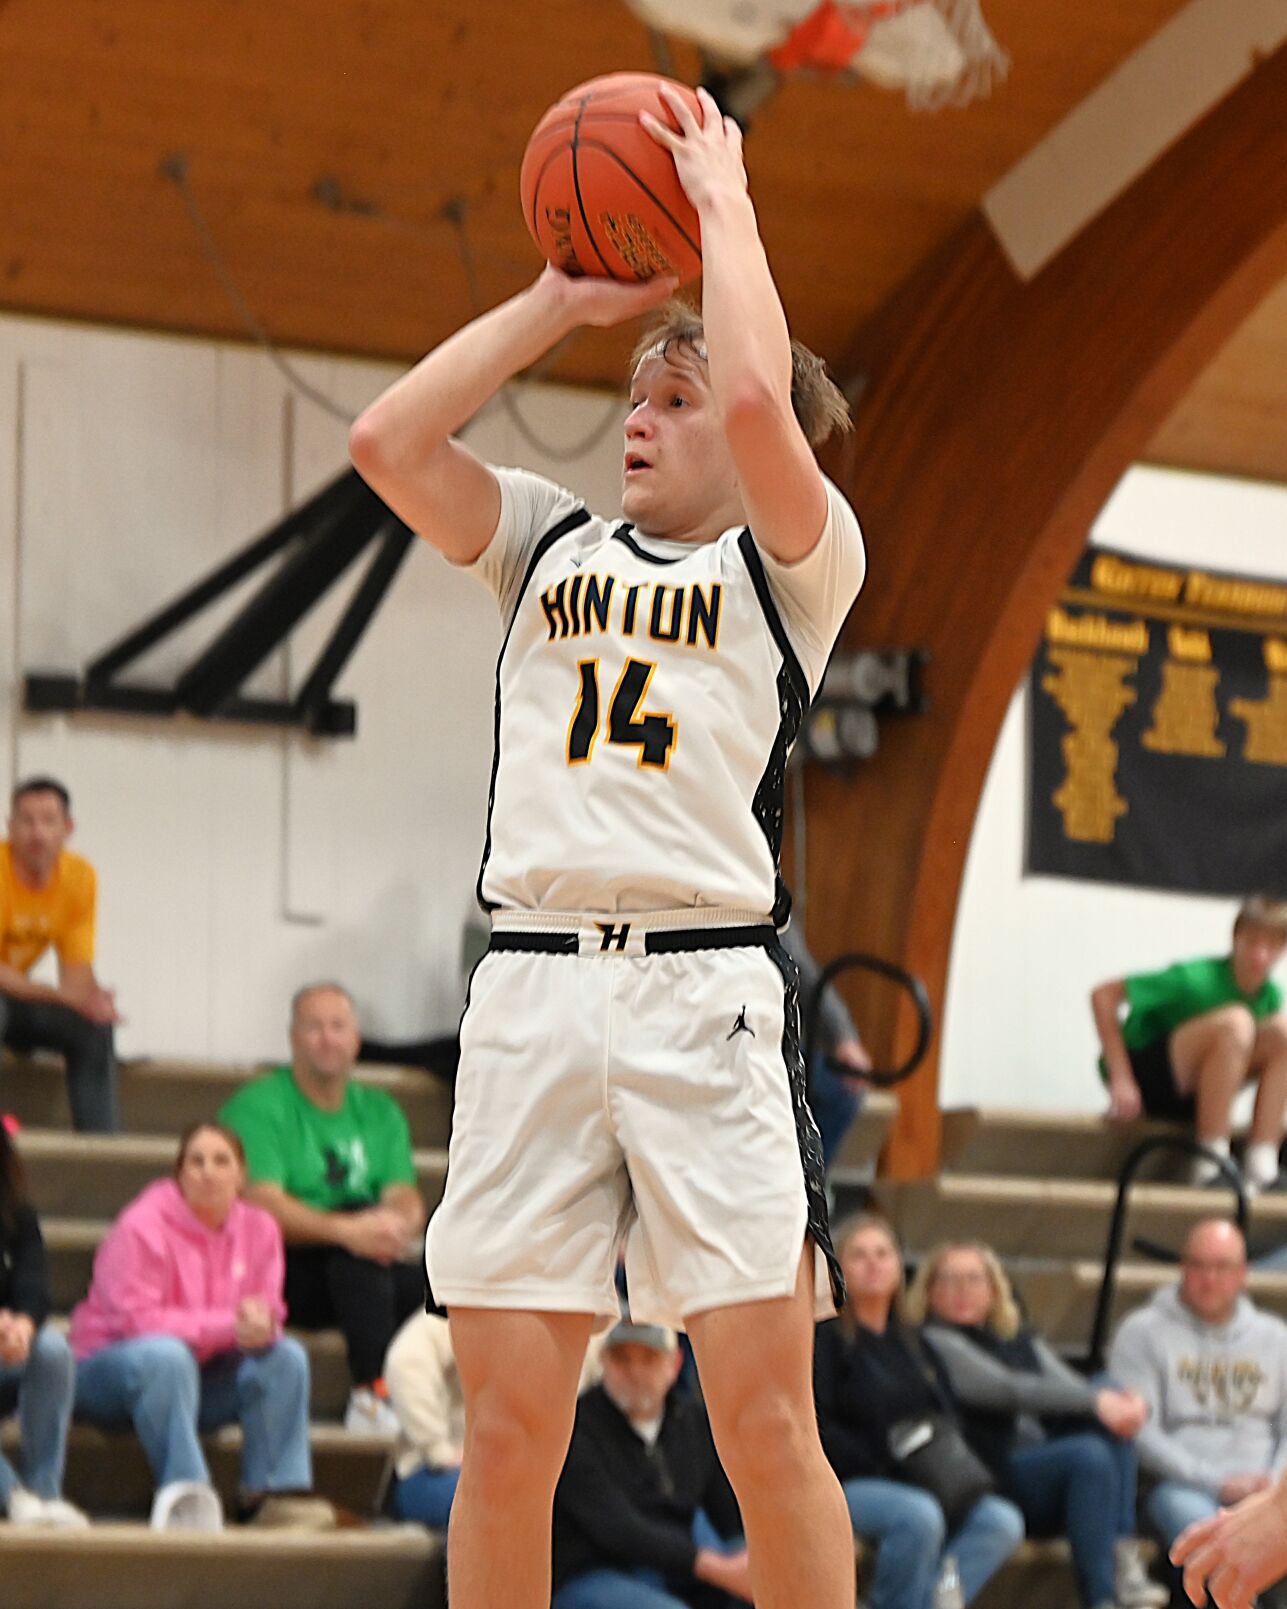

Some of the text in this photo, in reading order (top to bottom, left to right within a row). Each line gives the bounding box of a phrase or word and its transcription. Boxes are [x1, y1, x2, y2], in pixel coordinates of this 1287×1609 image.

[540, 573, 723, 650] HINTON
[566, 656, 678, 773] 14
[593, 921, 631, 953] H
